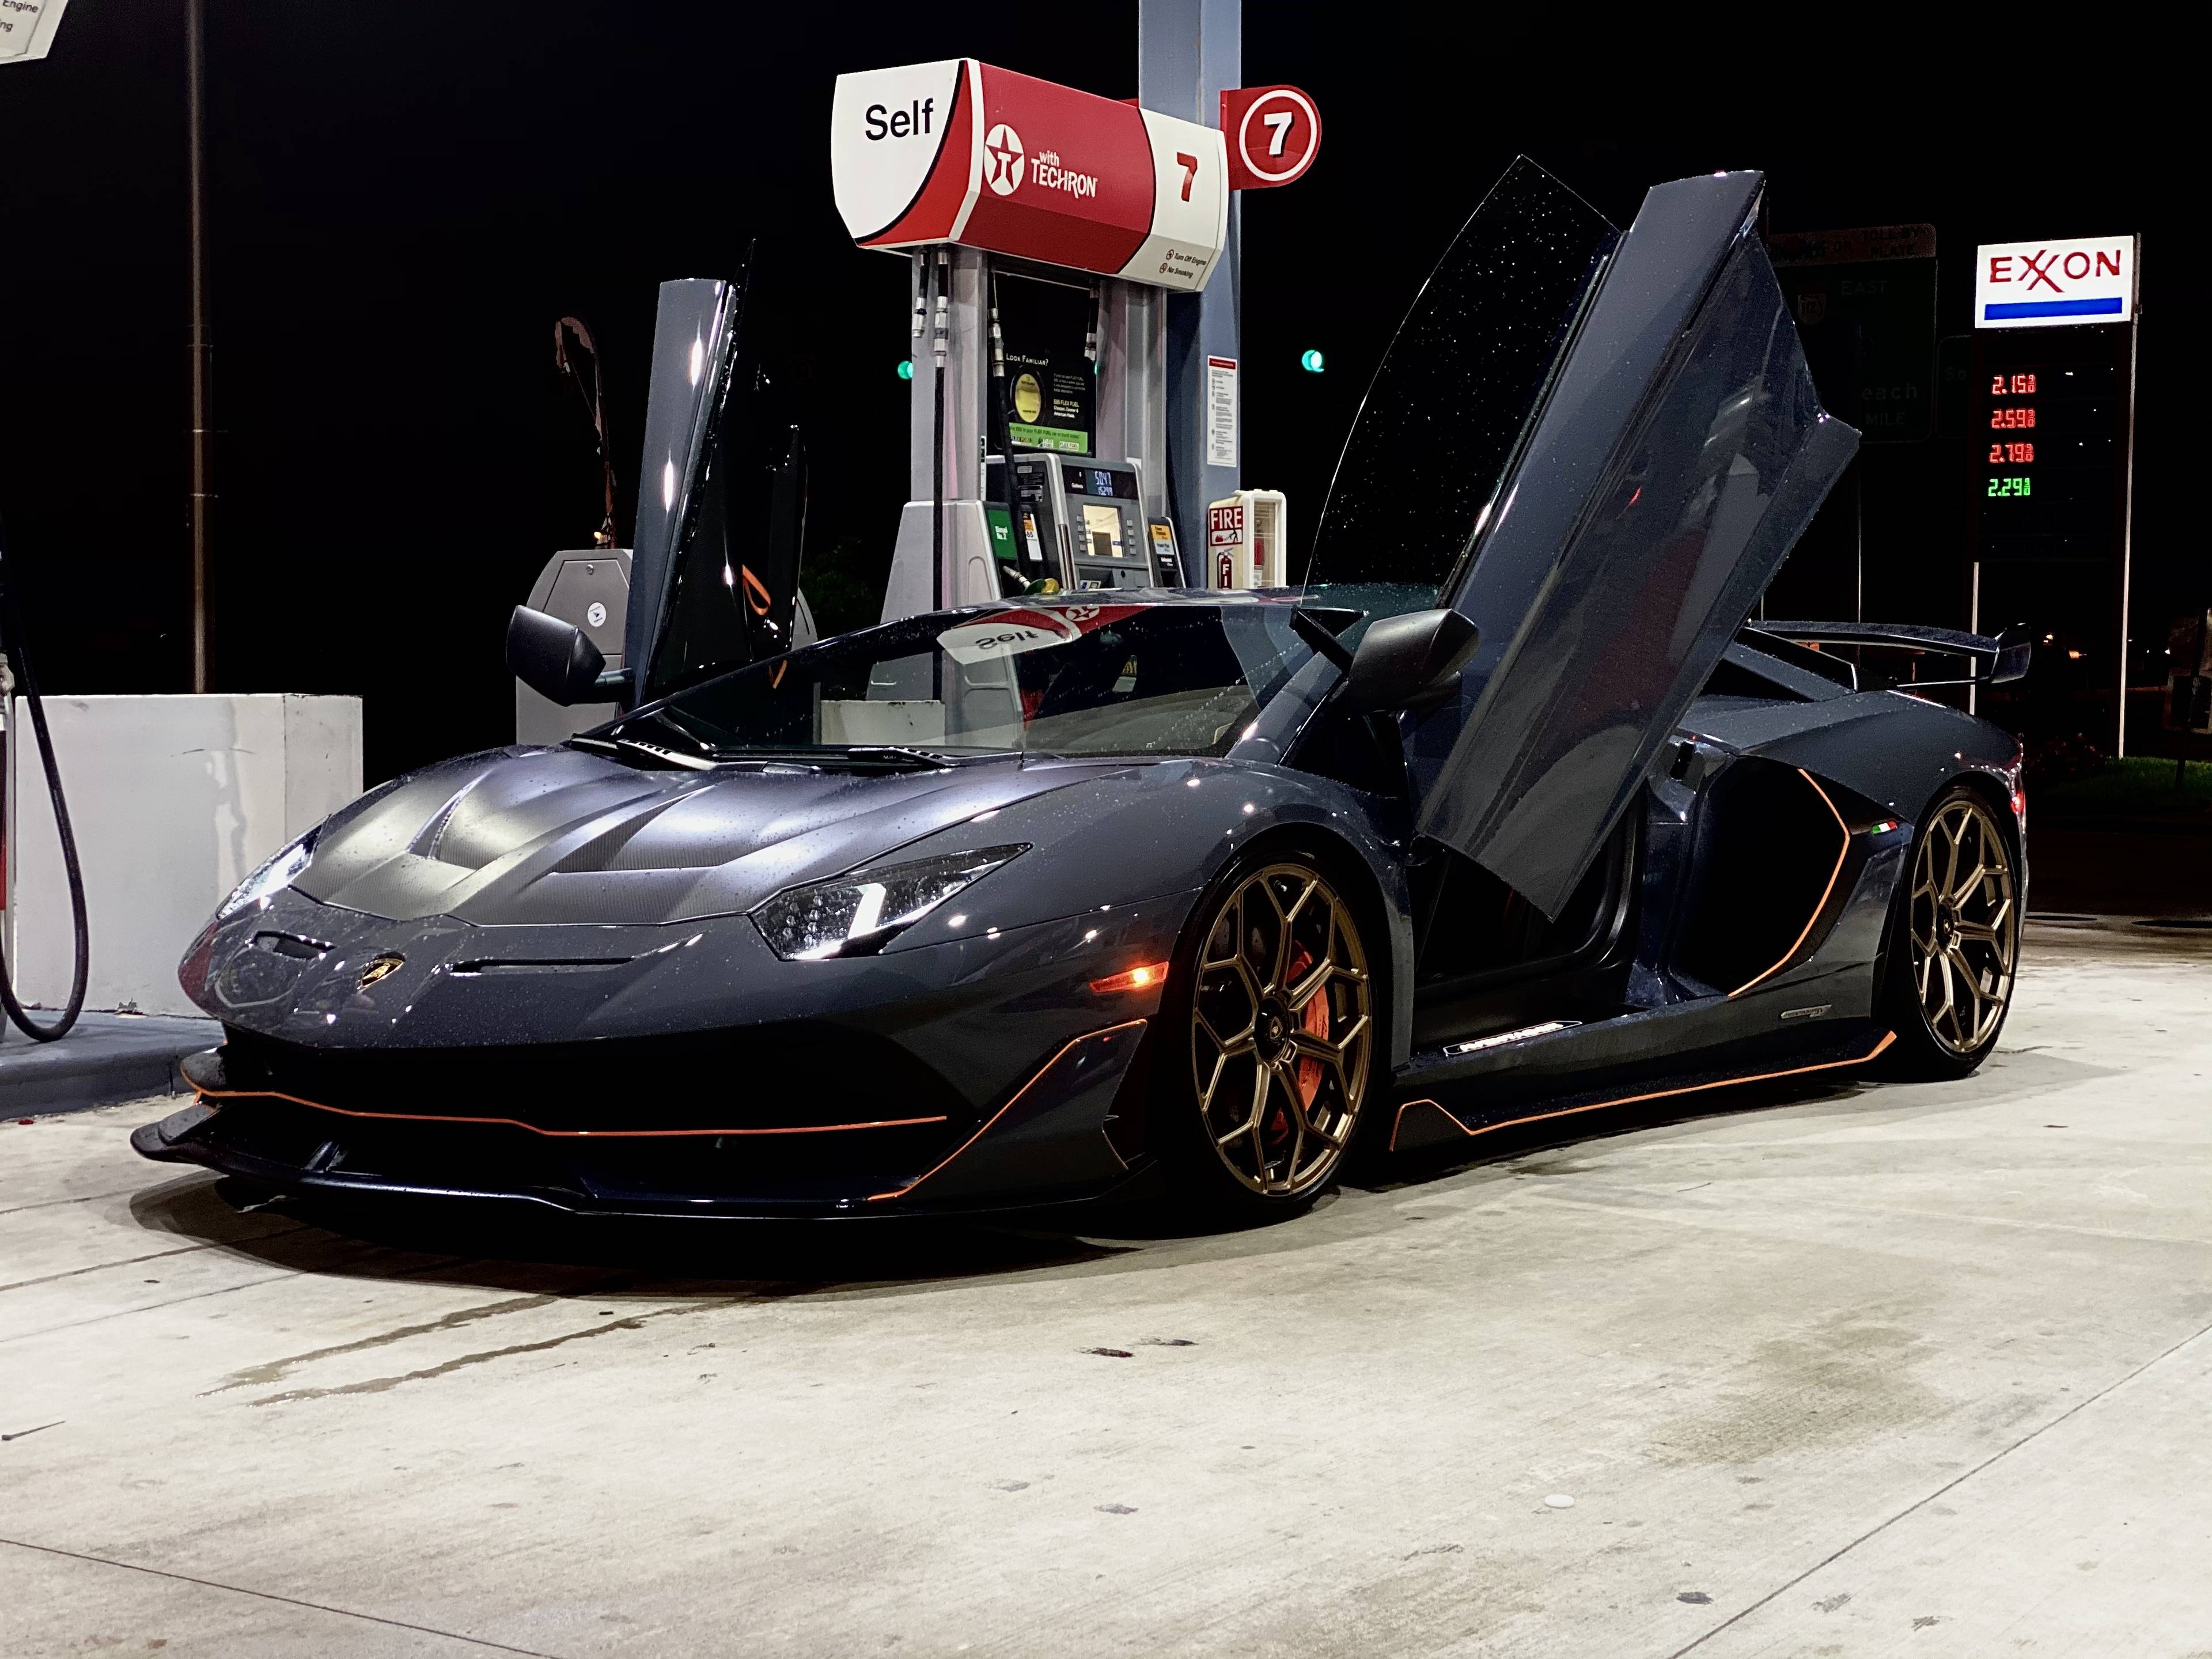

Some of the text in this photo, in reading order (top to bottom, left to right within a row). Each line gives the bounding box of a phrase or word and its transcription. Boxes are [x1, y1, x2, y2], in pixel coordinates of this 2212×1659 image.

[865, 97, 934, 141] Self
[1264, 111, 1293, 156] 7
[1039, 150, 1059, 167] with
[1031, 158, 1097, 199] TECHRON
[1177, 151, 1198, 202] 7
[1191, 257, 1206, 266] Engine
[1989, 249, 2121, 293] EXXON
[1174, 268, 1194, 279] Smoking
[1861, 382, 1918, 401] each
[1988, 478, 2022, 497] 2.29
[1211, 508, 1242, 529] FIRE
